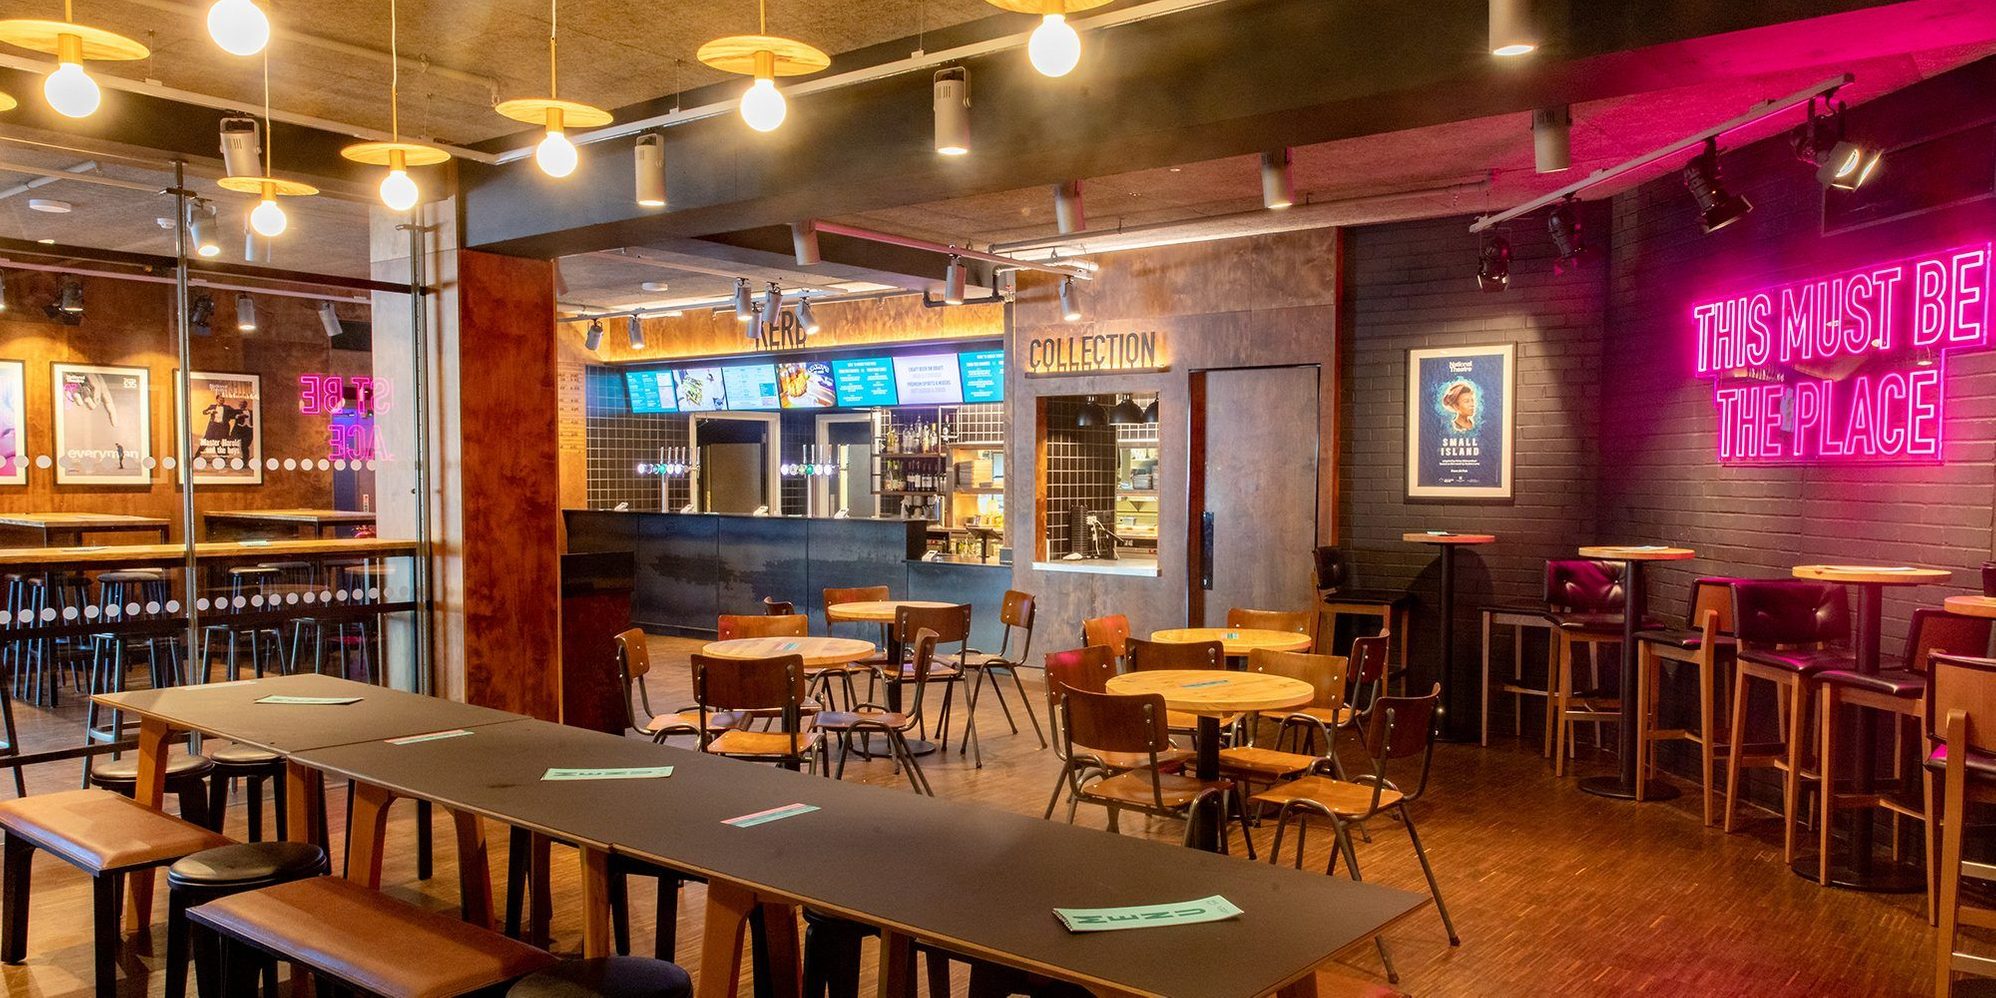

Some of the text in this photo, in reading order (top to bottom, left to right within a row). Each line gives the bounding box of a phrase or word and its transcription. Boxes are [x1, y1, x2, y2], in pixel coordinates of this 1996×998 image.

[1694, 250, 1984, 373] THIS MUST BE
[1029, 331, 1156, 371] COLLECTION
[1717, 369, 1938, 457] THE PLACE
[1440, 447, 1480, 456] ISLAND
[1442, 438, 1478, 447] SMALL
[67, 449, 139, 461] everyman
[1072, 907, 1207, 925] MENU
